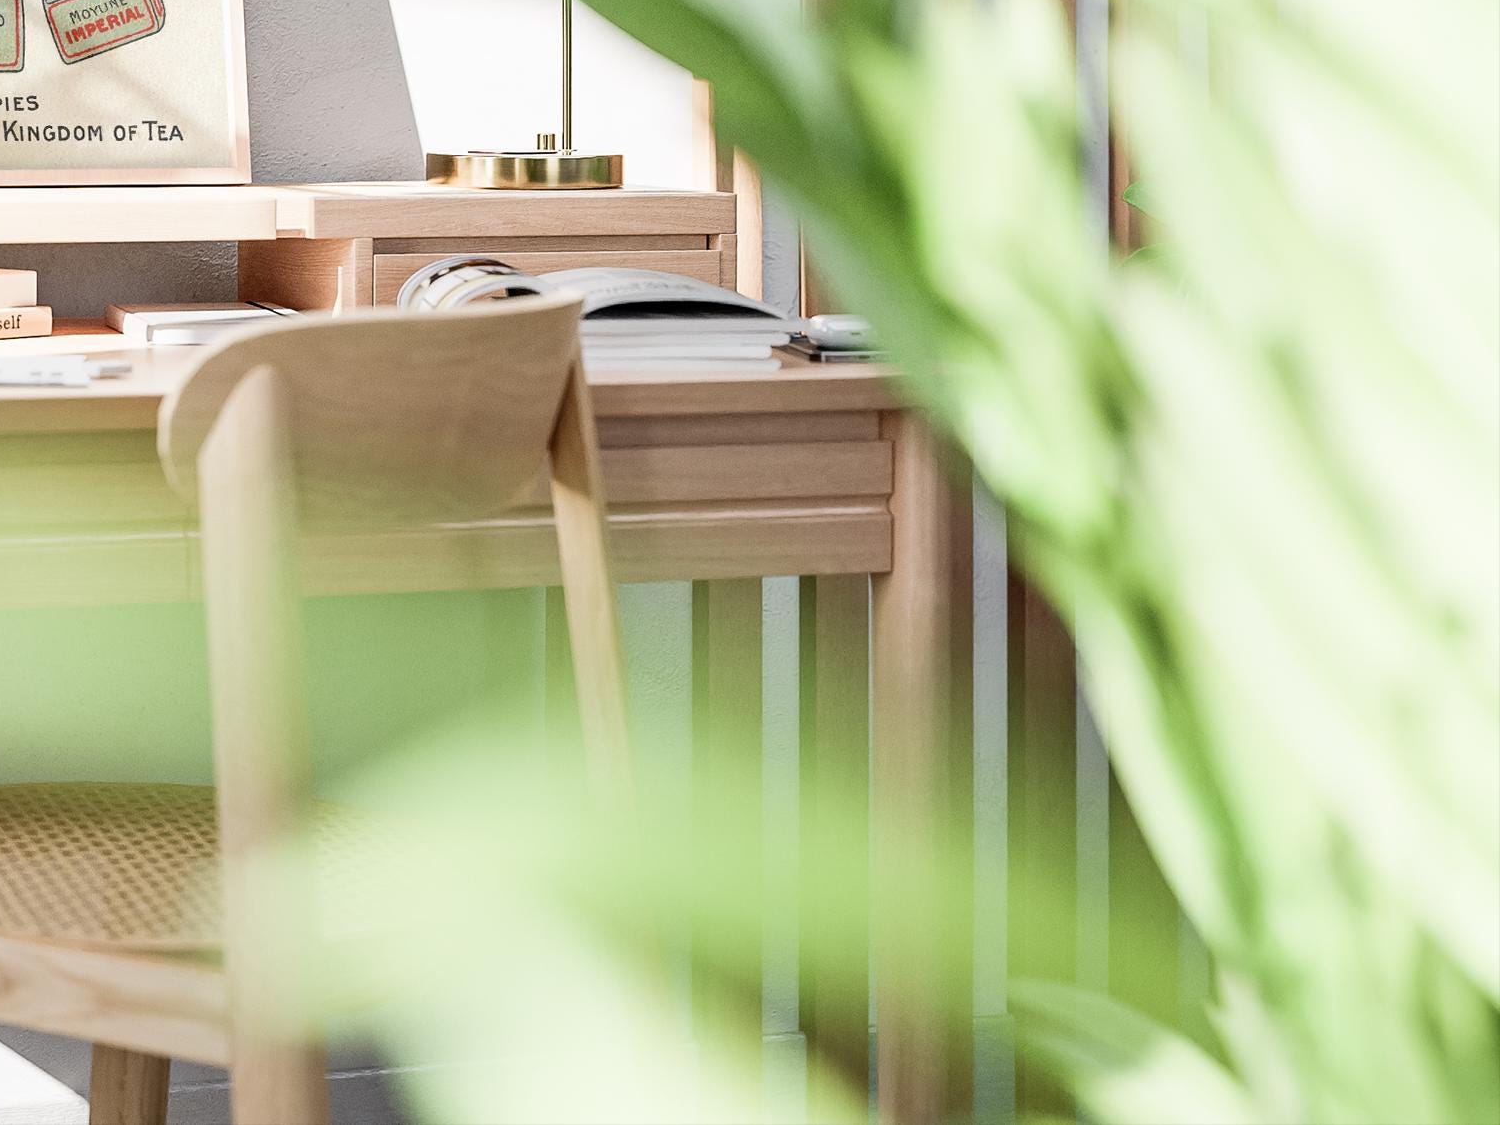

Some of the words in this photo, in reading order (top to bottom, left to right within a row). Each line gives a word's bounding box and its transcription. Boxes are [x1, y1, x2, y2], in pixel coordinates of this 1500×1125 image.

[65, 6, 145, 45] IMPERIAL
[3, 120, 103, 142] KINGDOM
[114, 125, 137, 141] OF
[142, 121, 184, 141] TEA
